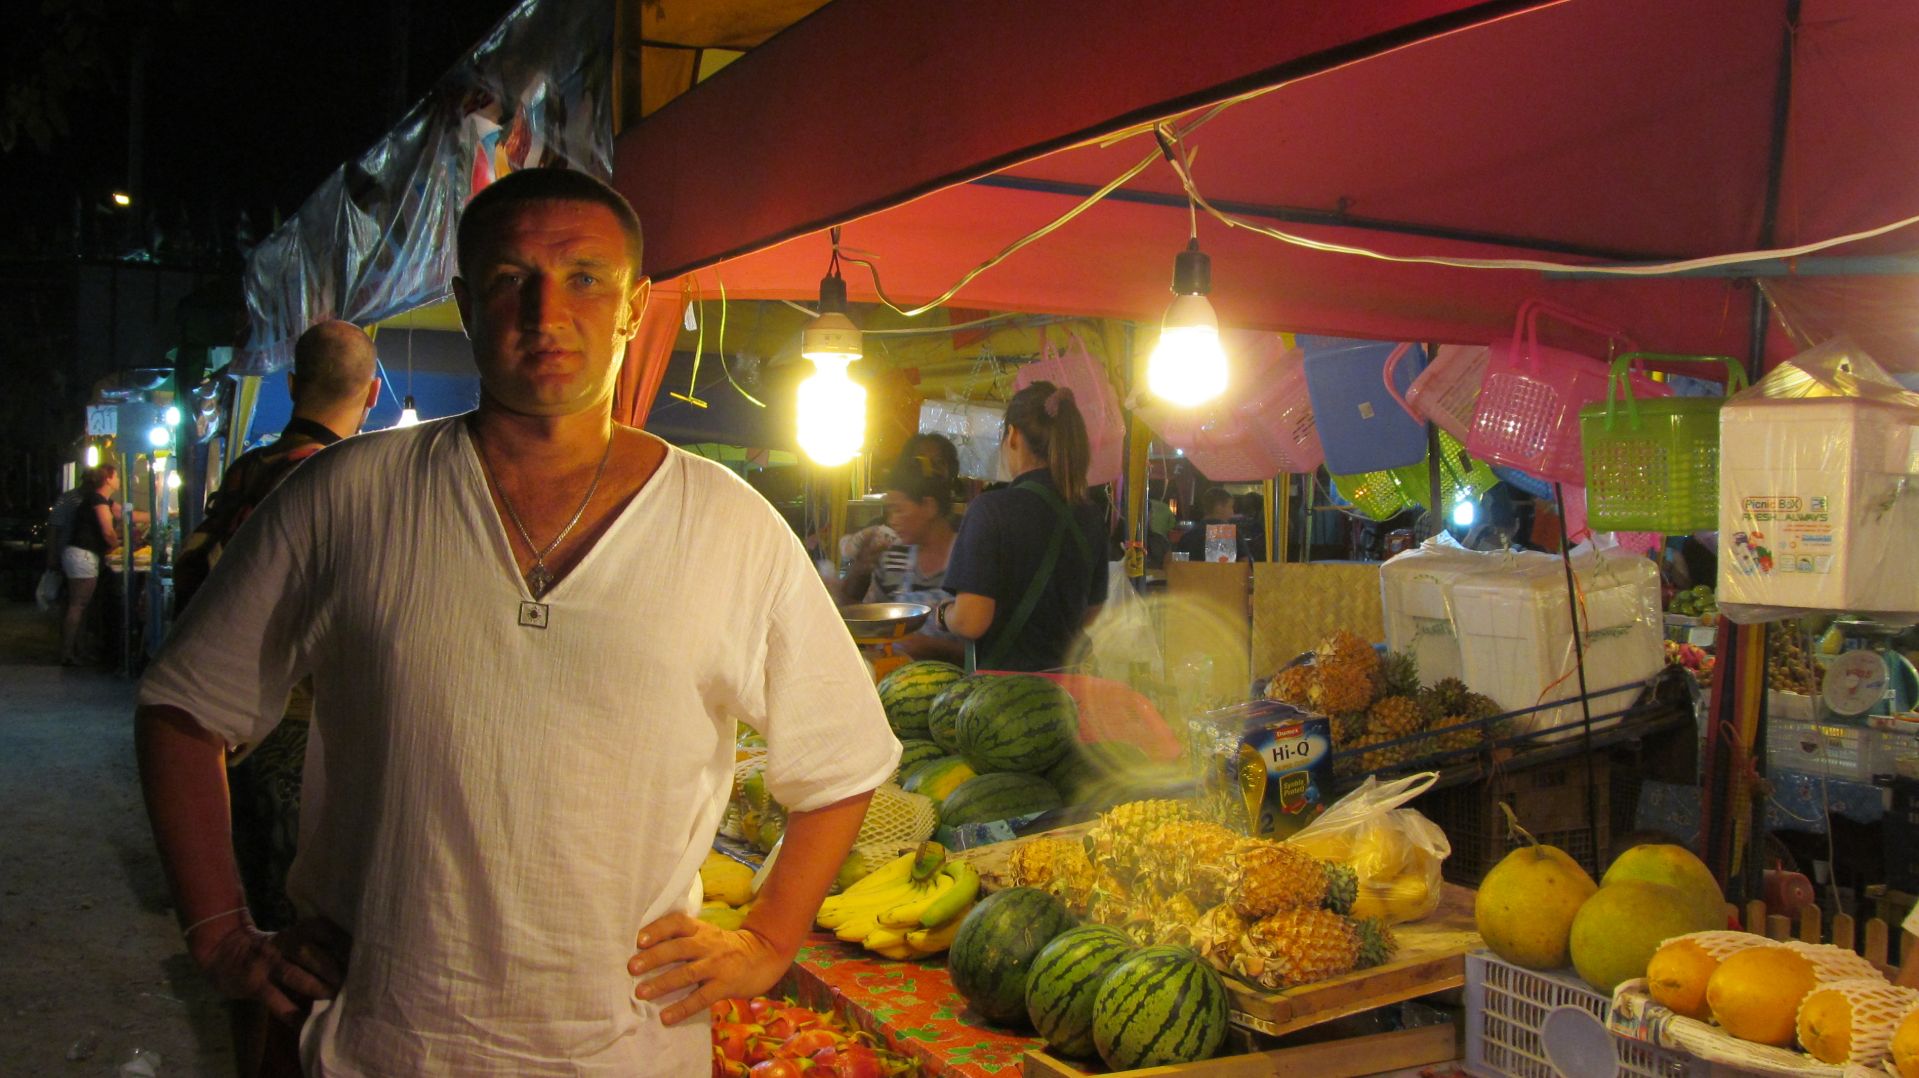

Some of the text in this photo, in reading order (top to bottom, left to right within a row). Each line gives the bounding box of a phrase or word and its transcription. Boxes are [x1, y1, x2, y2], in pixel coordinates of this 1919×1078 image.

[1745, 498, 1776, 509] Picnic
[1272, 741, 1310, 762] Hi-Q
[1261, 813, 1275, 834] 2
